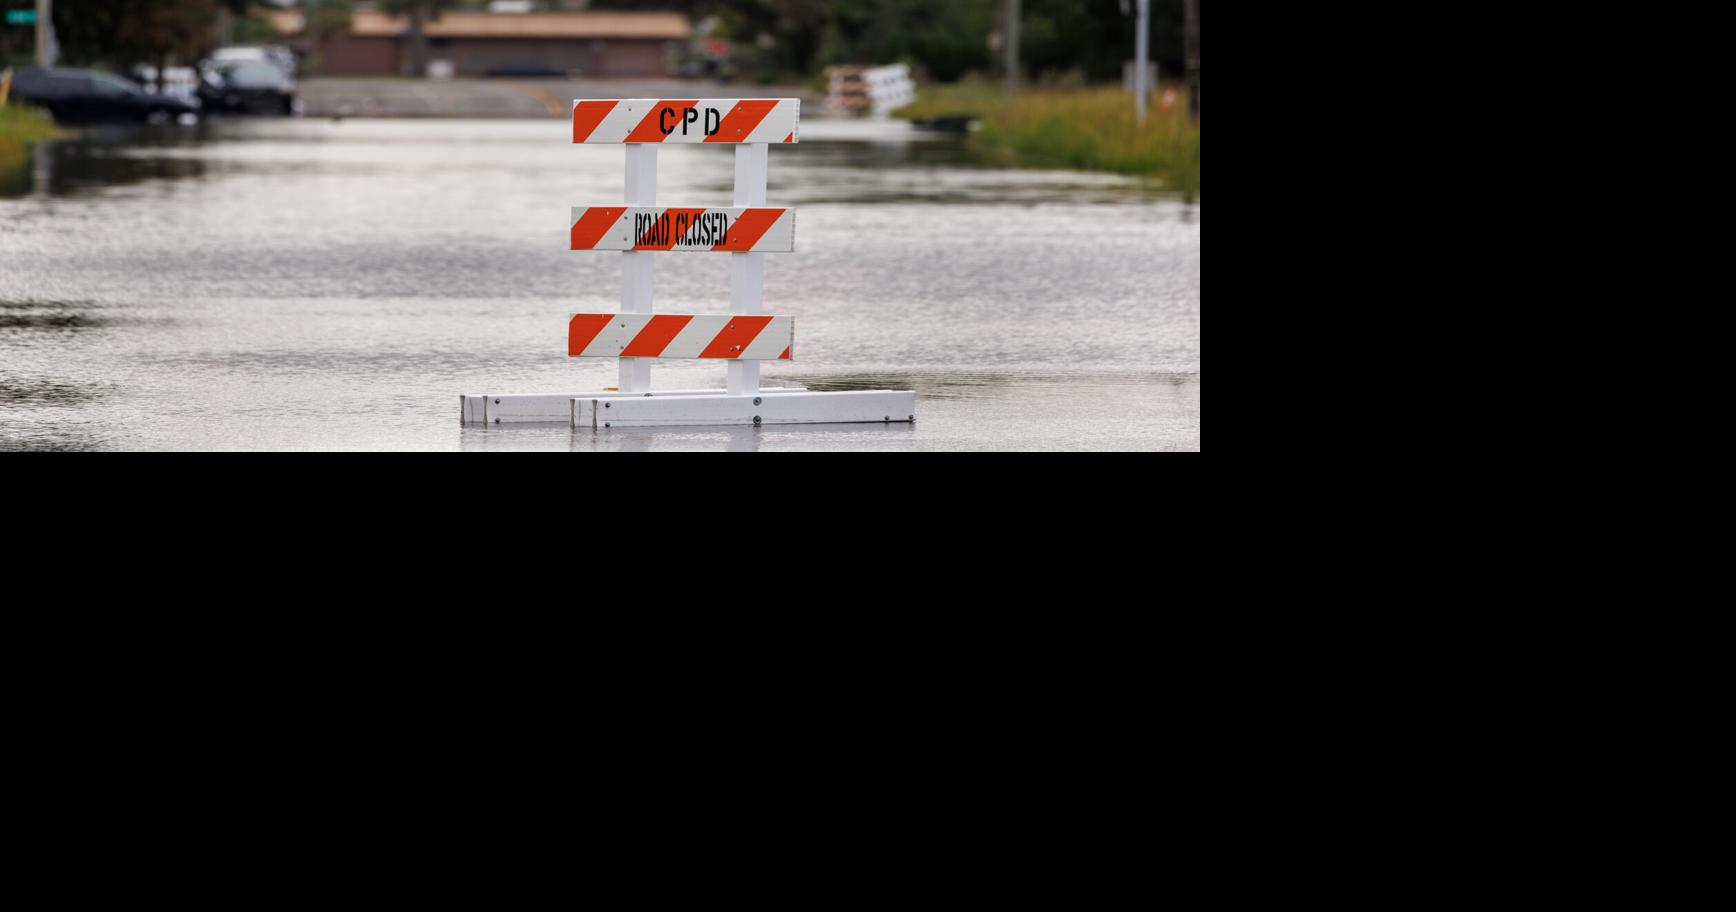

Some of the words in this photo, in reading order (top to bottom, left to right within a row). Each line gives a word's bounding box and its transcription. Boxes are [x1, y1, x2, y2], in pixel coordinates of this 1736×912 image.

[659, 107, 721, 136] CPD
[634, 212, 670, 246] ROAD
[675, 212, 728, 247] CLOSED
